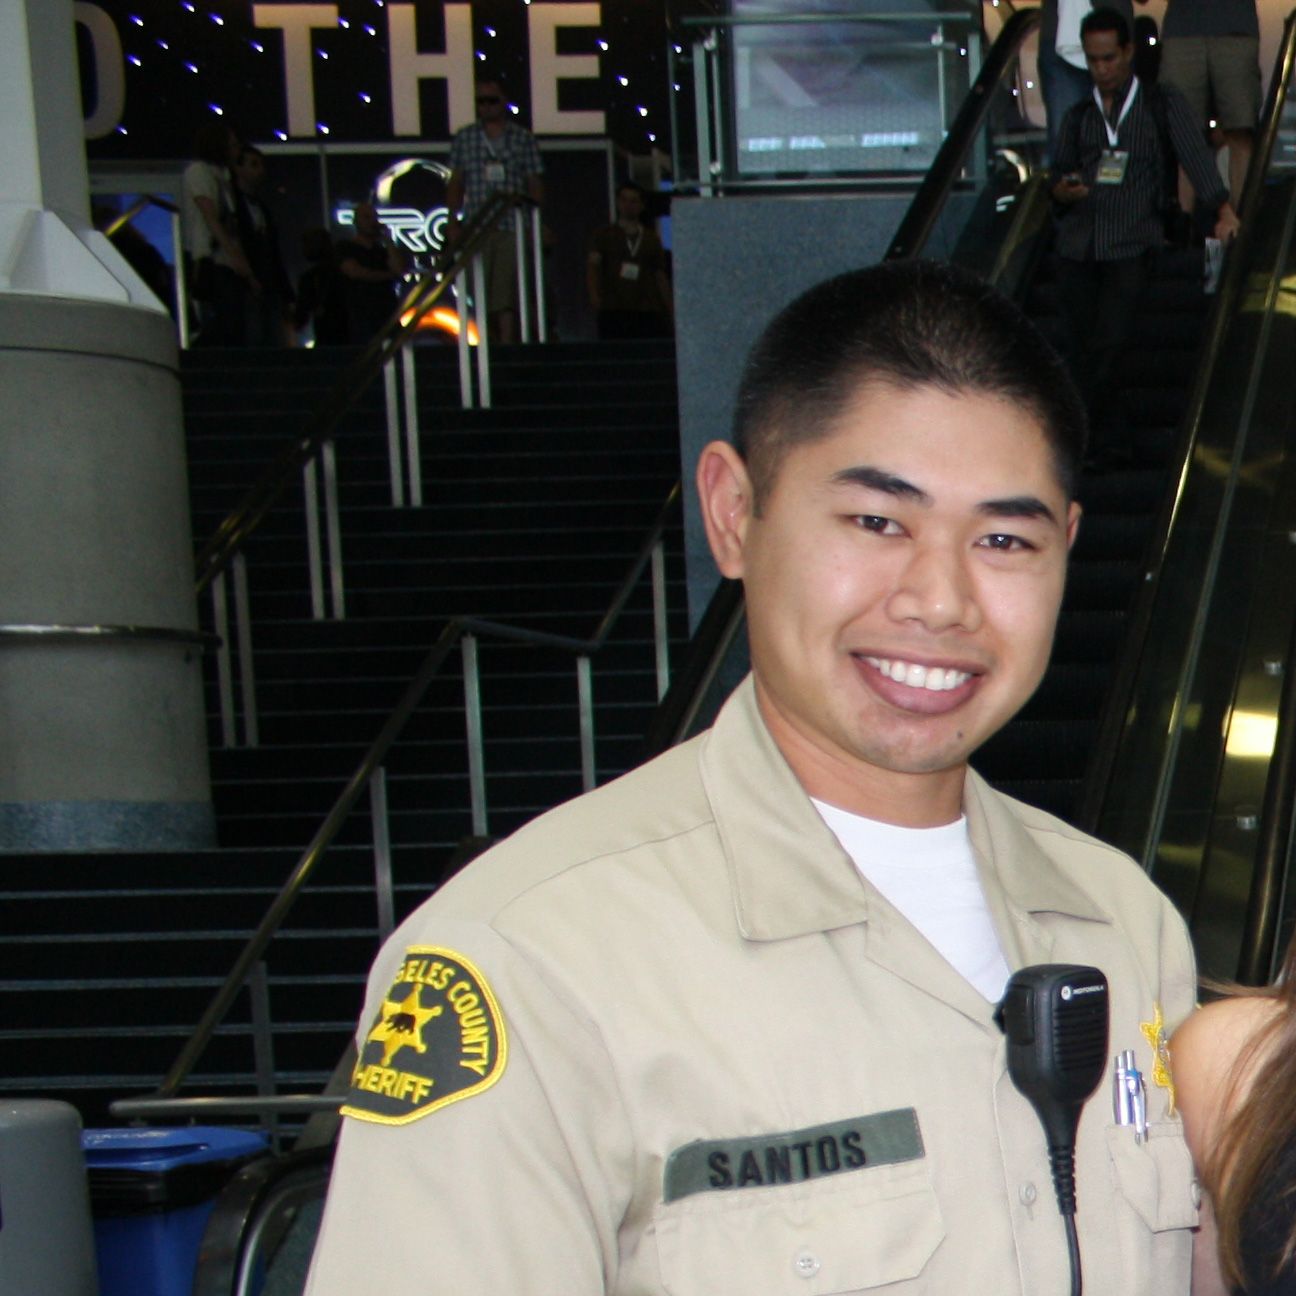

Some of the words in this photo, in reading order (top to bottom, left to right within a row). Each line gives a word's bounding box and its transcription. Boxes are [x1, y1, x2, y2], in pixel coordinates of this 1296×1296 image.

[252, 2, 607, 138] THE
[447, 981, 490, 1076] COUNTY
[352, 1065, 434, 1104] HERIFF
[708, 1130, 867, 1188] SANTOS
